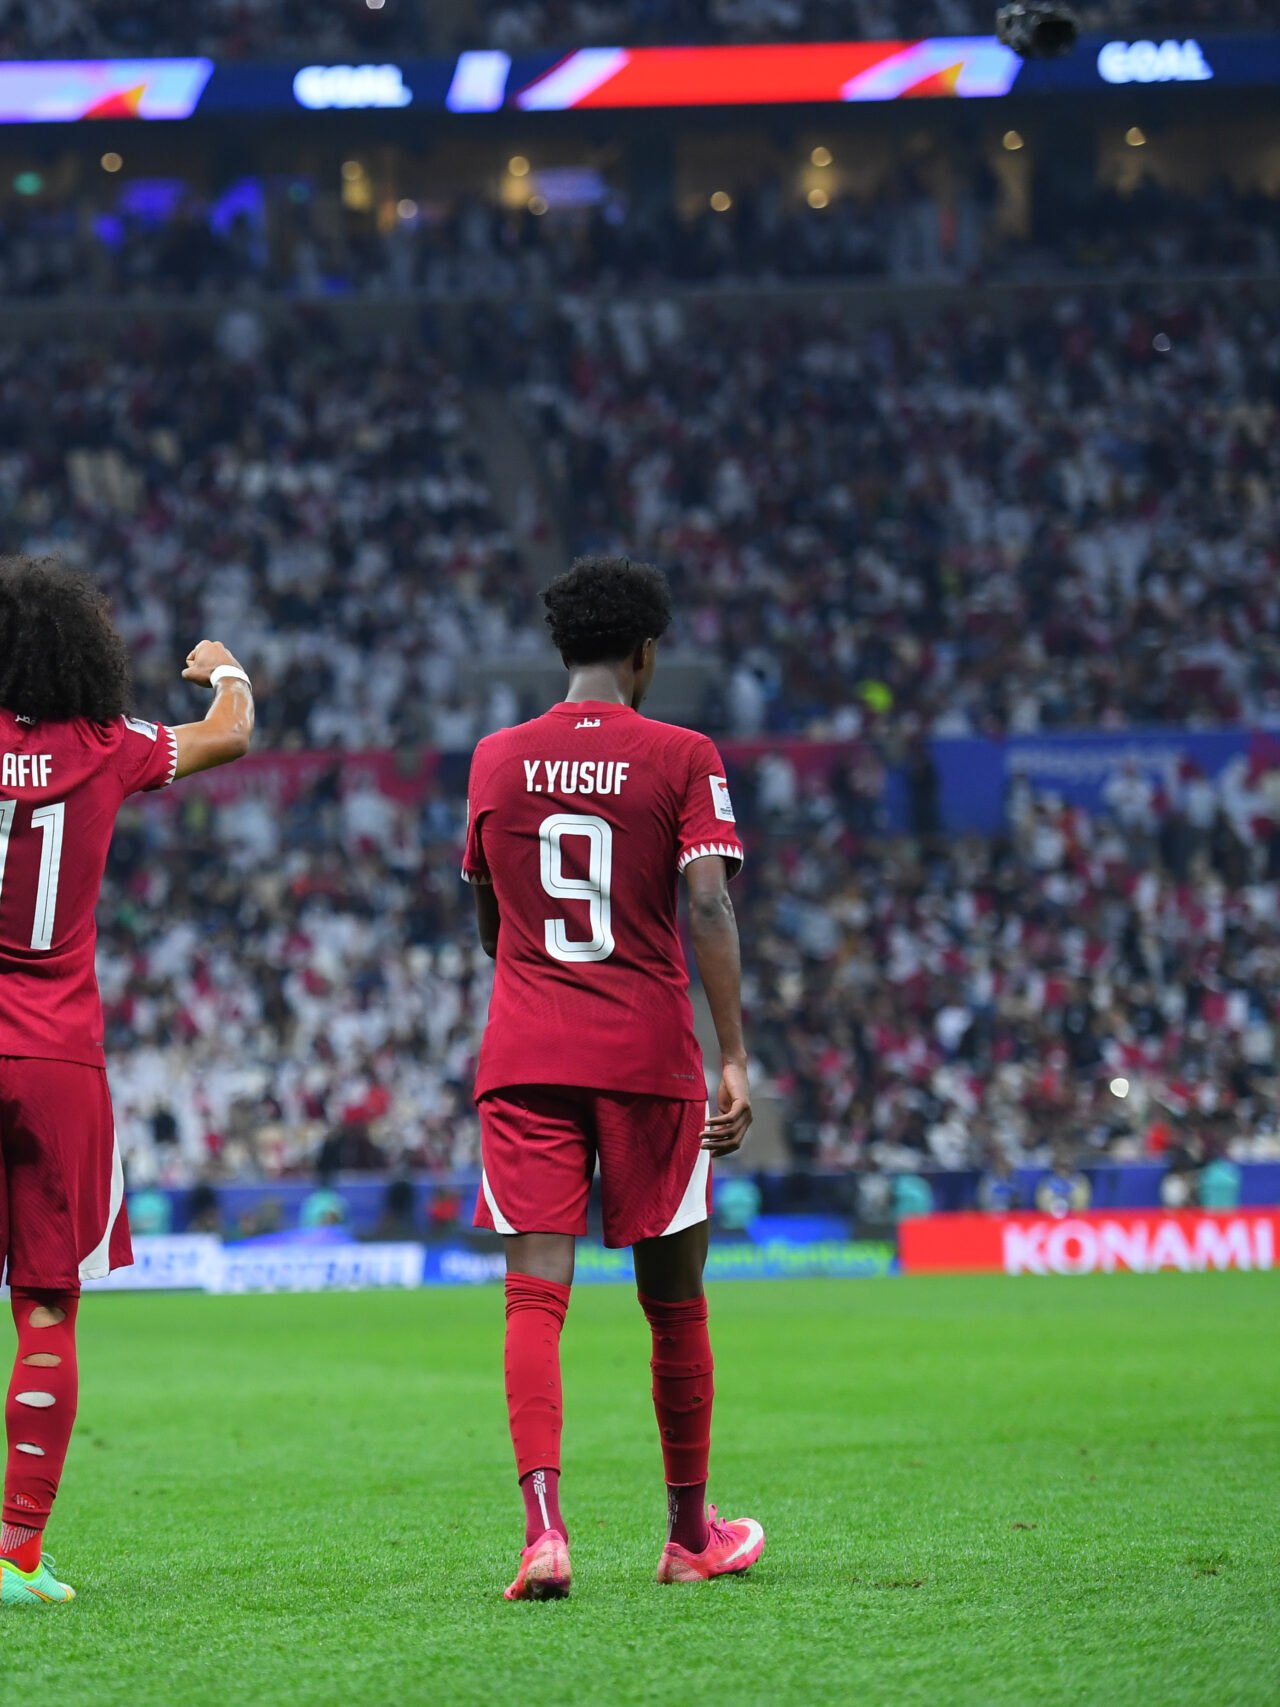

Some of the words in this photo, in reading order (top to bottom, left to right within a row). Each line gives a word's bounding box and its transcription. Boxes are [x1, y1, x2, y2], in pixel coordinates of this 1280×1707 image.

[1096, 38, 1215, 84] GOAL
[574, 717, 601, 730] قطر
[1, 752, 53, 787] AFIF
[523, 760, 630, 795] Y.YUSUF
[538, 813, 616, 963] 9
[1001, 1217, 1275, 1276] KONAMI
